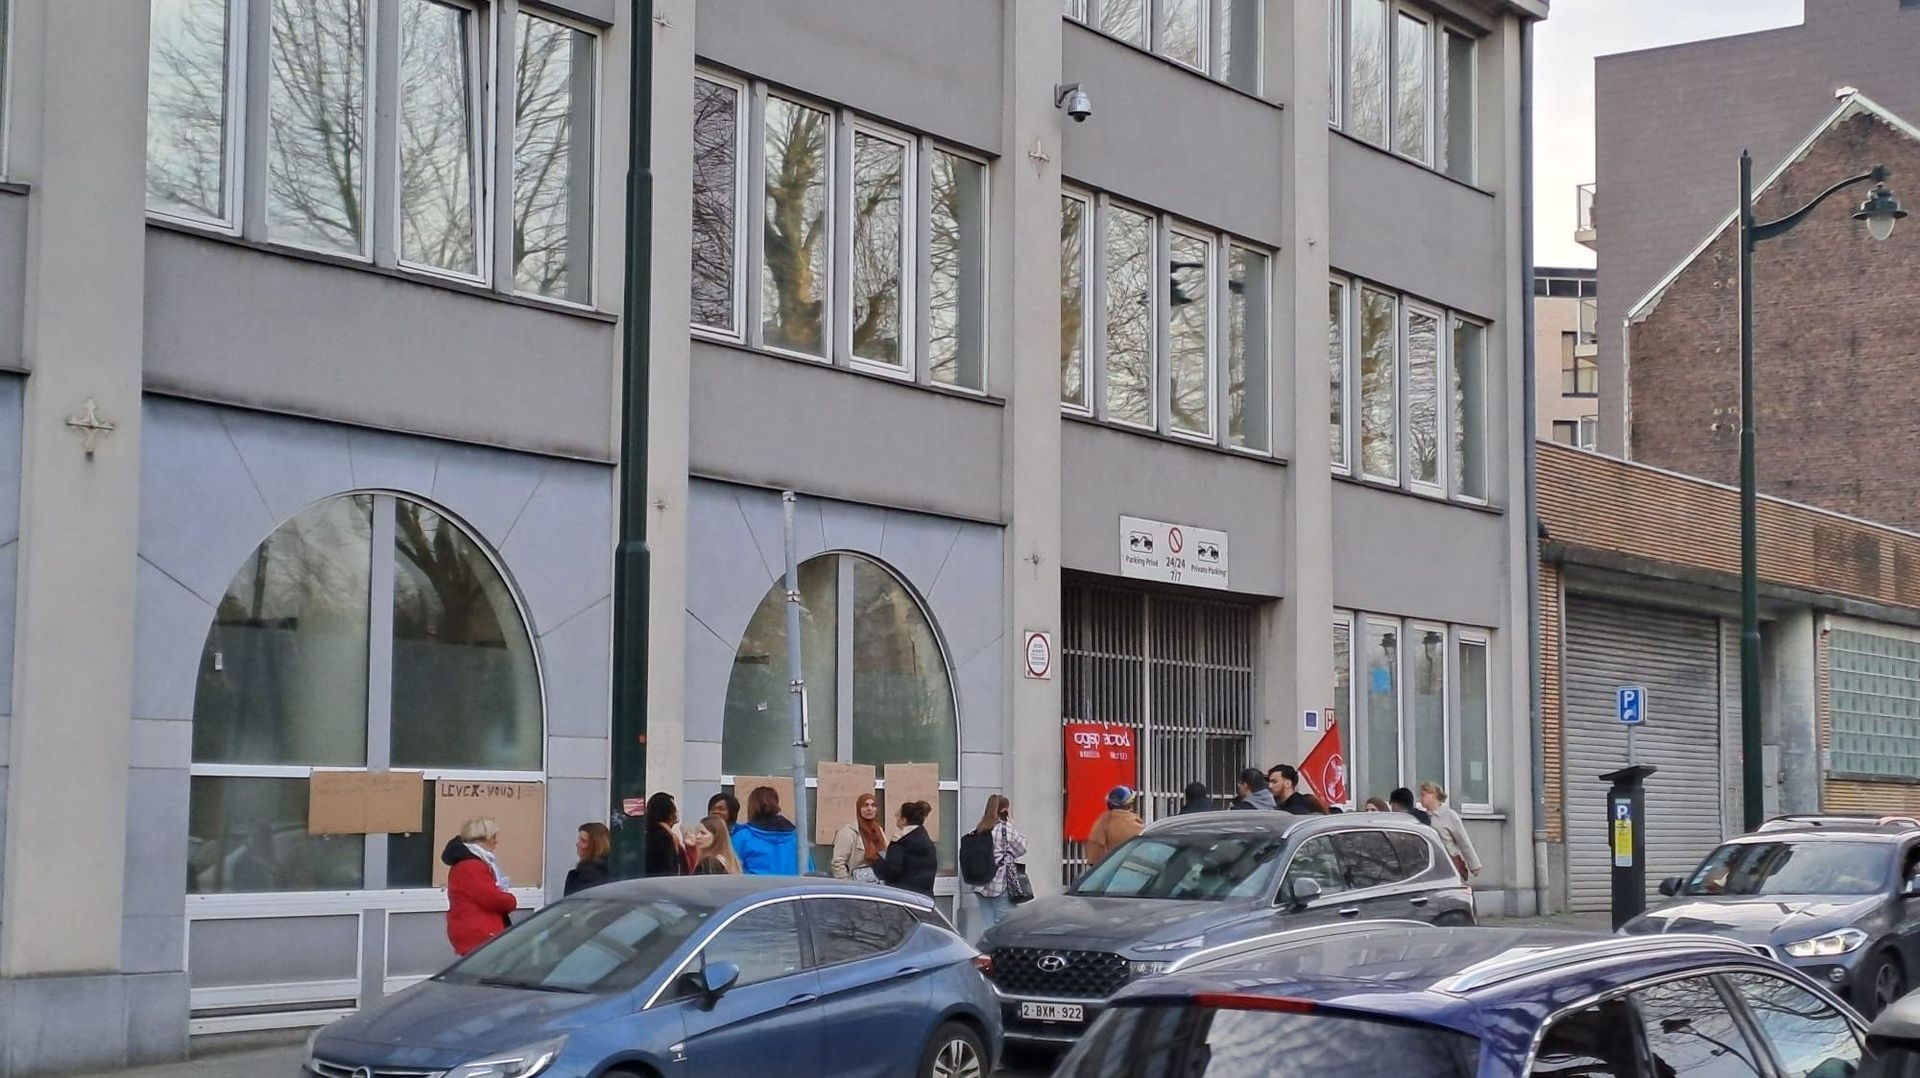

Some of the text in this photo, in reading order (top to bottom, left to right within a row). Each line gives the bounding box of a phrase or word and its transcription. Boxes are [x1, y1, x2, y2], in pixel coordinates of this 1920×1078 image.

[1126, 555, 1145, 567] Parking
[1166, 557, 1185, 568] 24/24
[1170, 571, 1181, 582] 7/7
[1191, 564, 1226, 577] Private Parking
[1624, 691, 1634, 708] P
[1617, 805, 1628, 819] P
